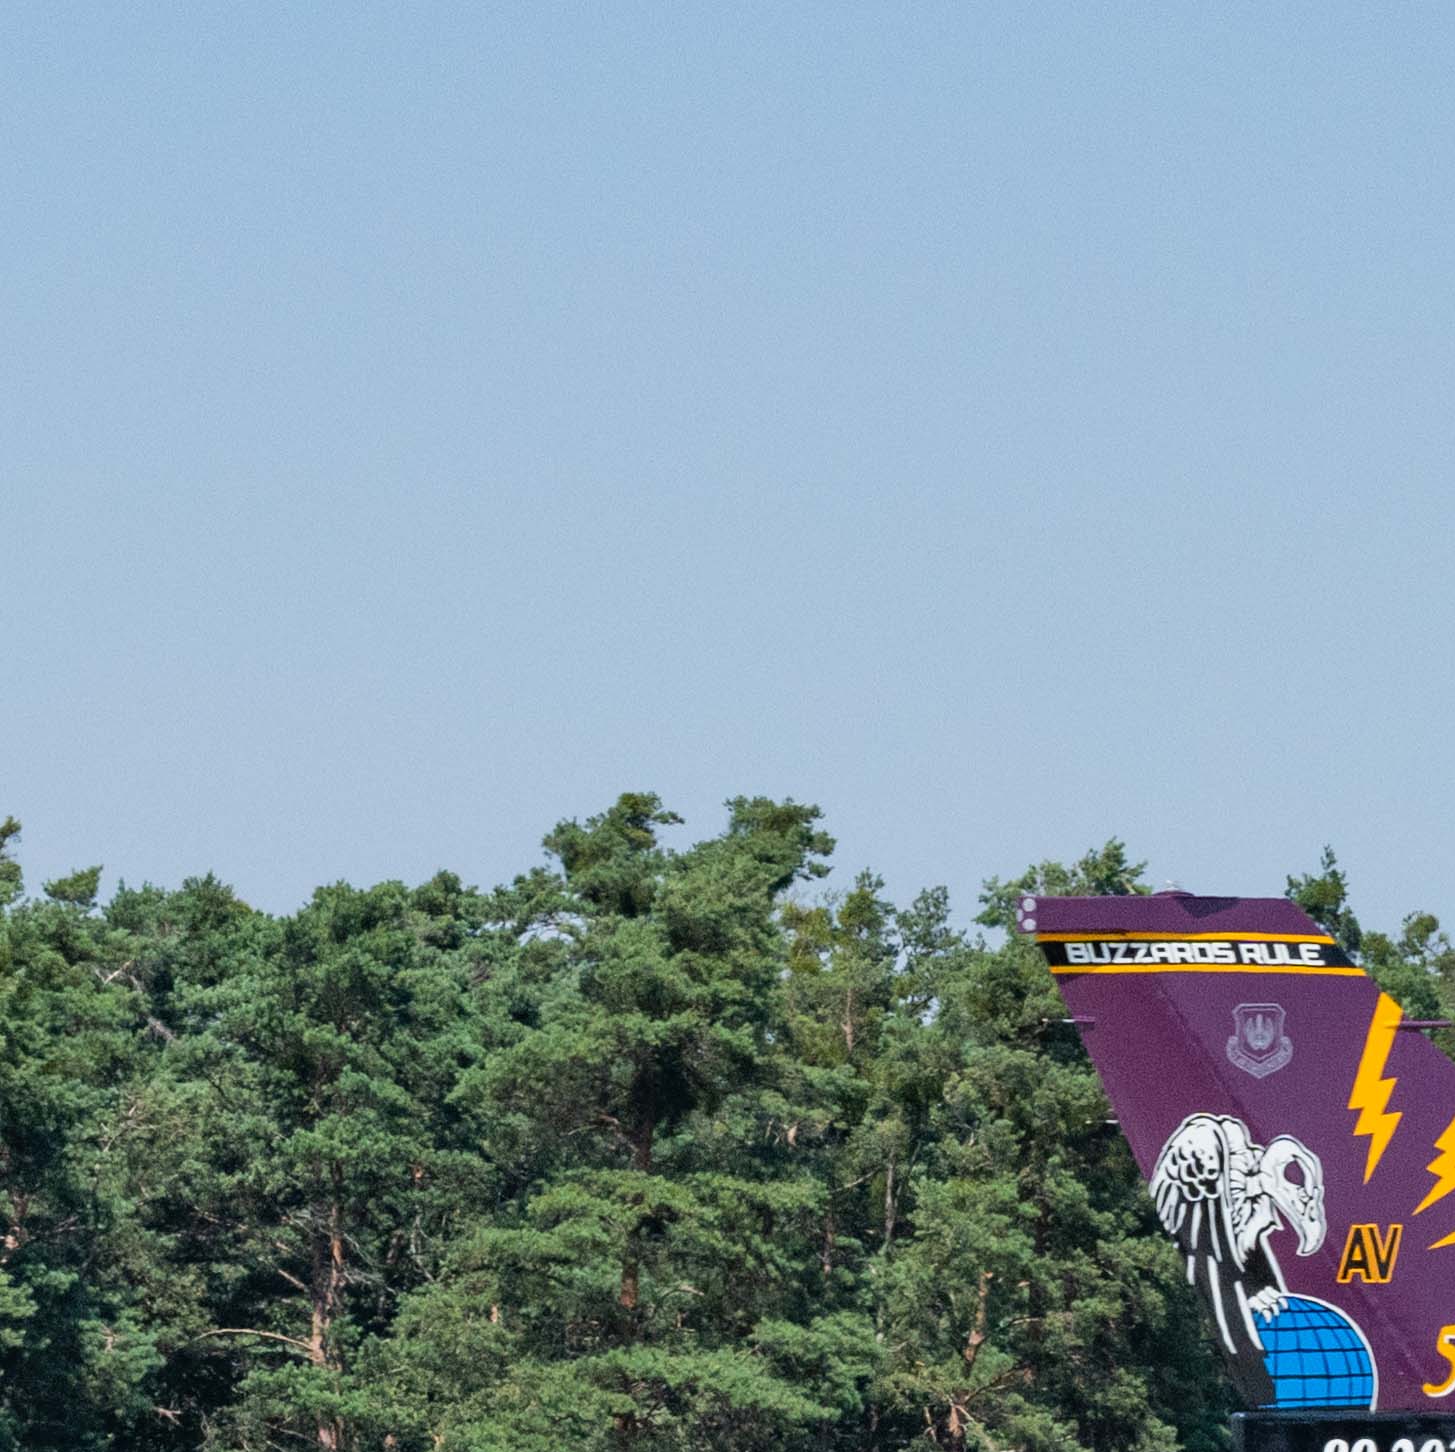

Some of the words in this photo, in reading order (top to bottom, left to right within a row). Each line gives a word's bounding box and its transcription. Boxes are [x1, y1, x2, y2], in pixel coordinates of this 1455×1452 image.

[1065, 942, 1236, 964] BUZZARDS
[1239, 943, 1326, 966] RULE
[1337, 1223, 1402, 1284] AV
